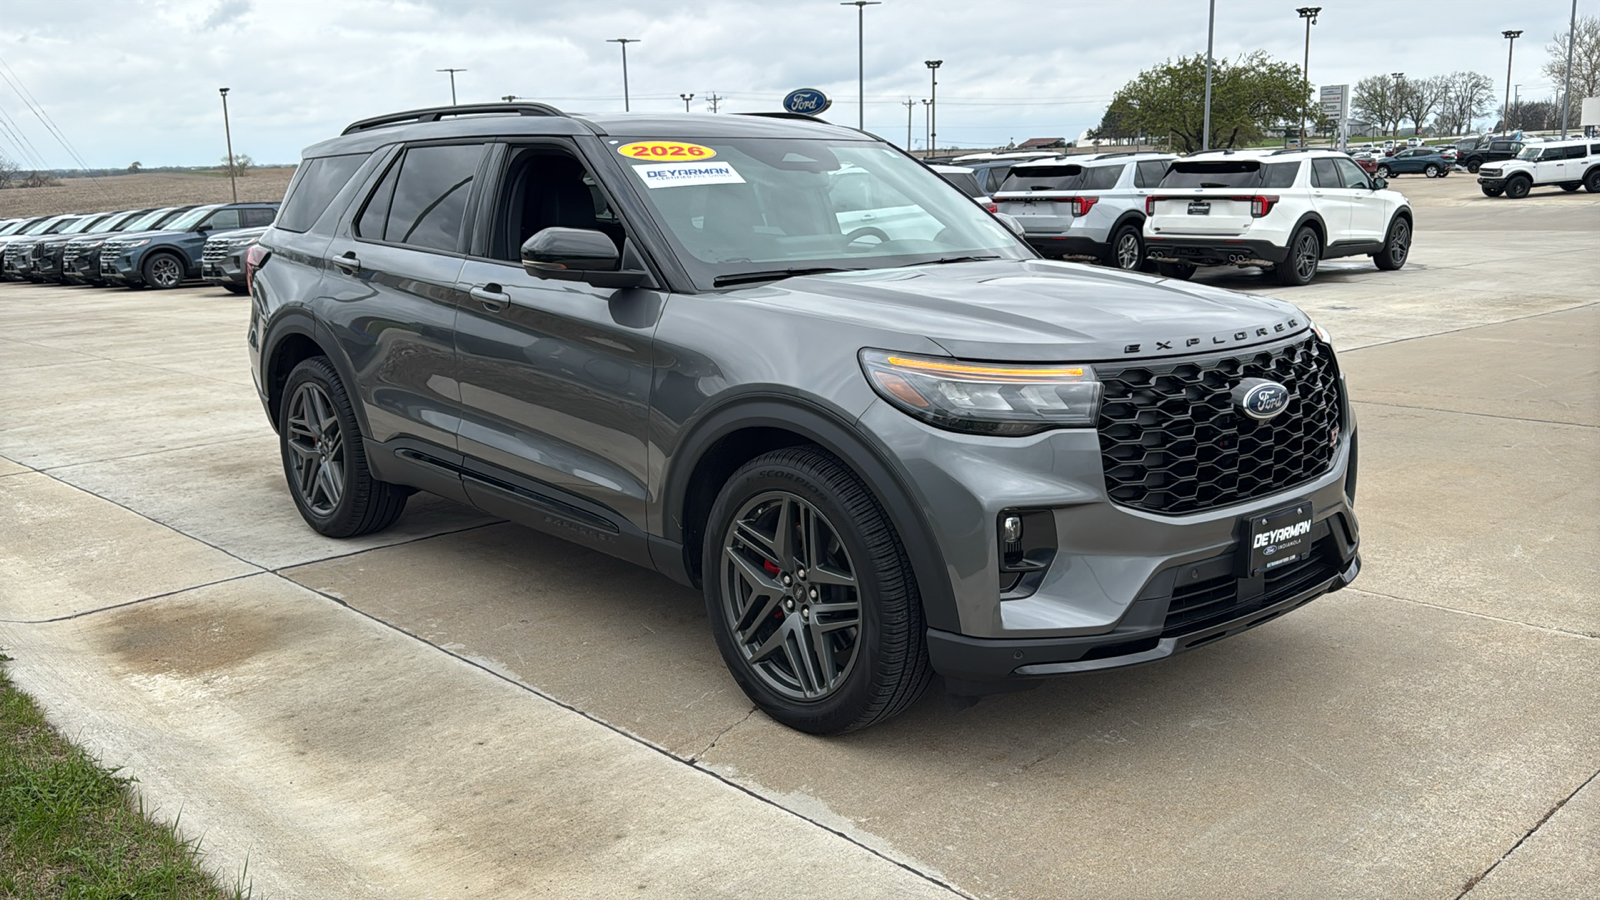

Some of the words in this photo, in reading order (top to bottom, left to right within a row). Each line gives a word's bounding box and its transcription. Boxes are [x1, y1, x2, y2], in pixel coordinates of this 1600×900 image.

[791, 93, 817, 110] Ford
[632, 146, 705, 156] 2026
[646, 168, 729, 178] DEYARMAN
[1124, 319, 1298, 353] EXPLORER
[1257, 390, 1282, 410] Ford
[760, 470, 827, 500] SCORPION
[1253, 519, 1311, 548] DEYARMAN
